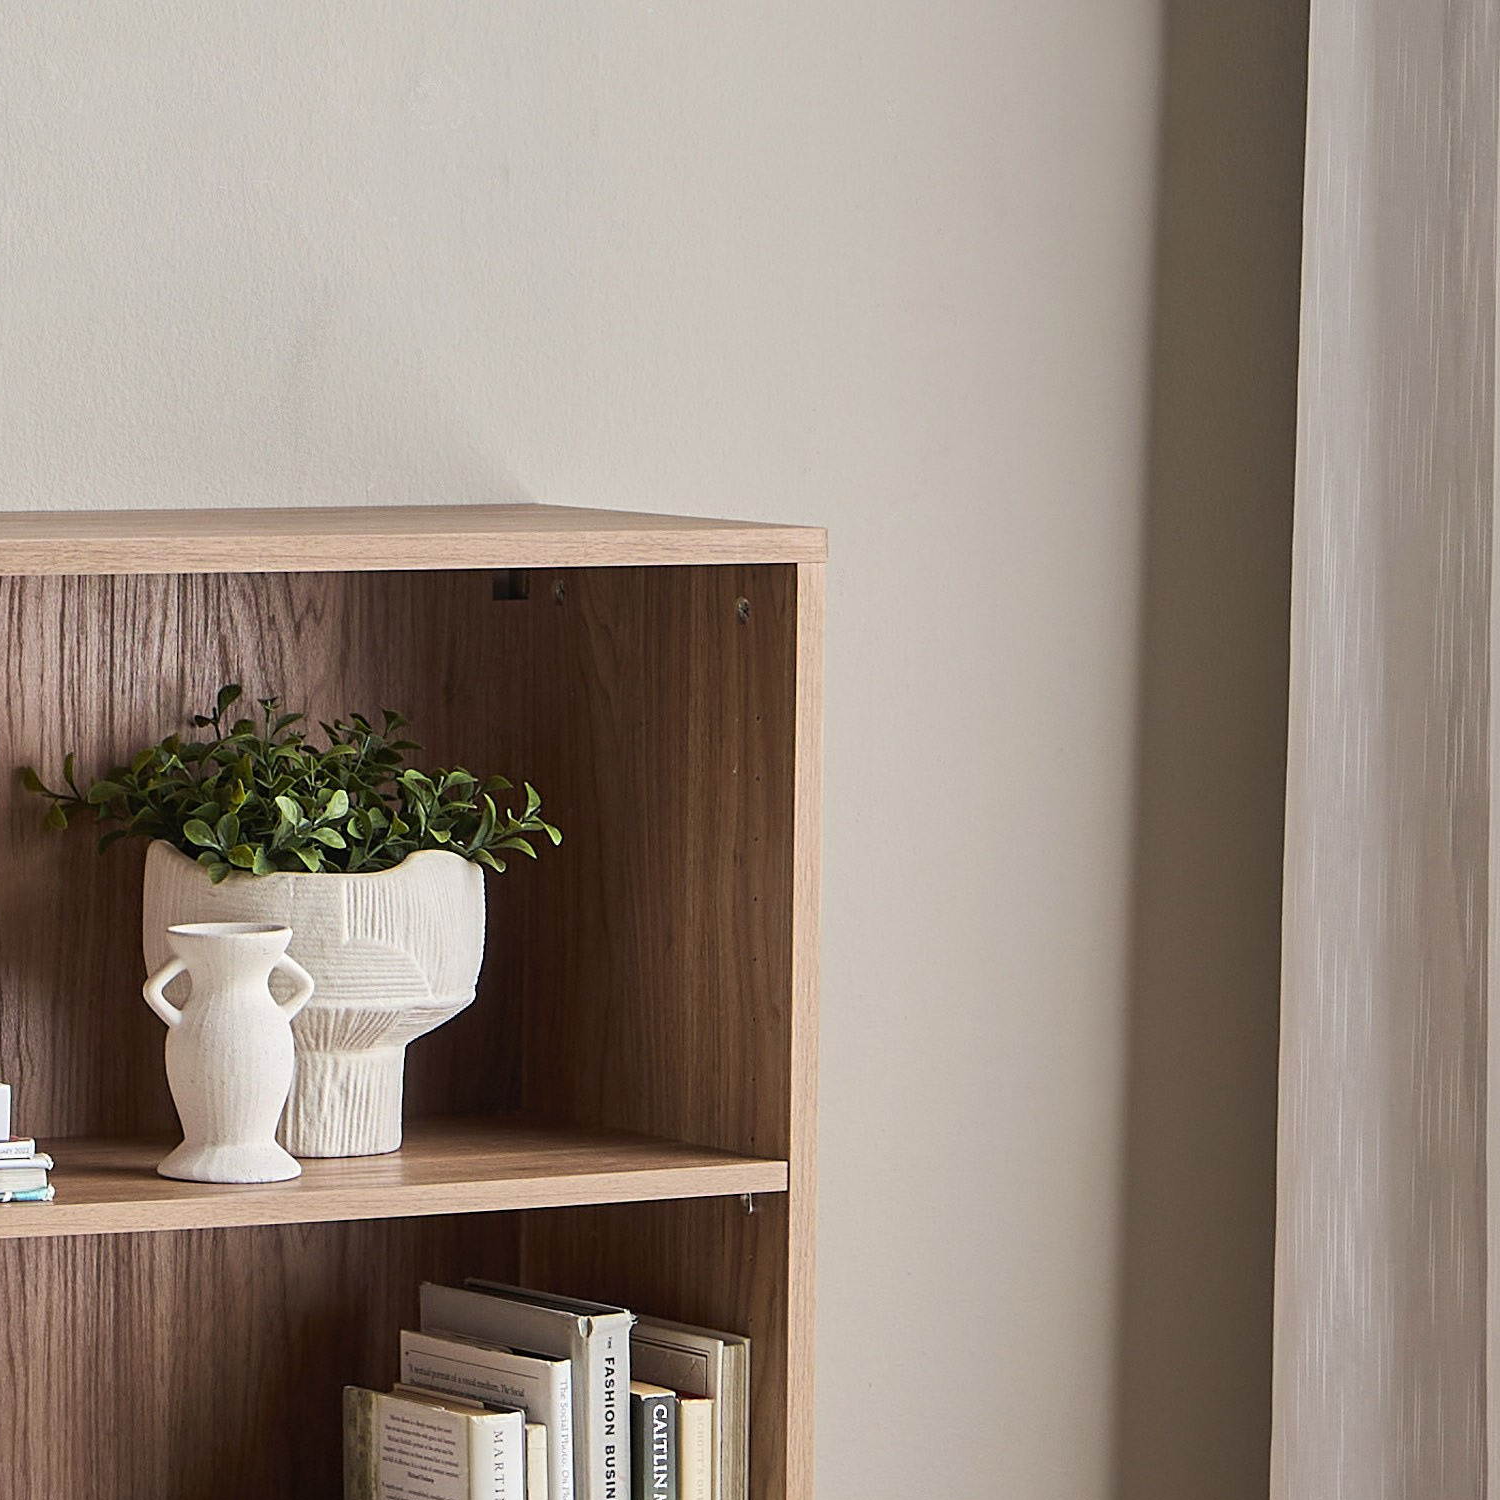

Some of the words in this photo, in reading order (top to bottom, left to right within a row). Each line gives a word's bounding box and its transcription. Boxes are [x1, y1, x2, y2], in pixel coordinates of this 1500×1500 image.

[559, 1402, 569, 1432] Social
[604, 1357, 615, 1436] FASHION
[653, 1404, 669, 1488] CAITLIN
